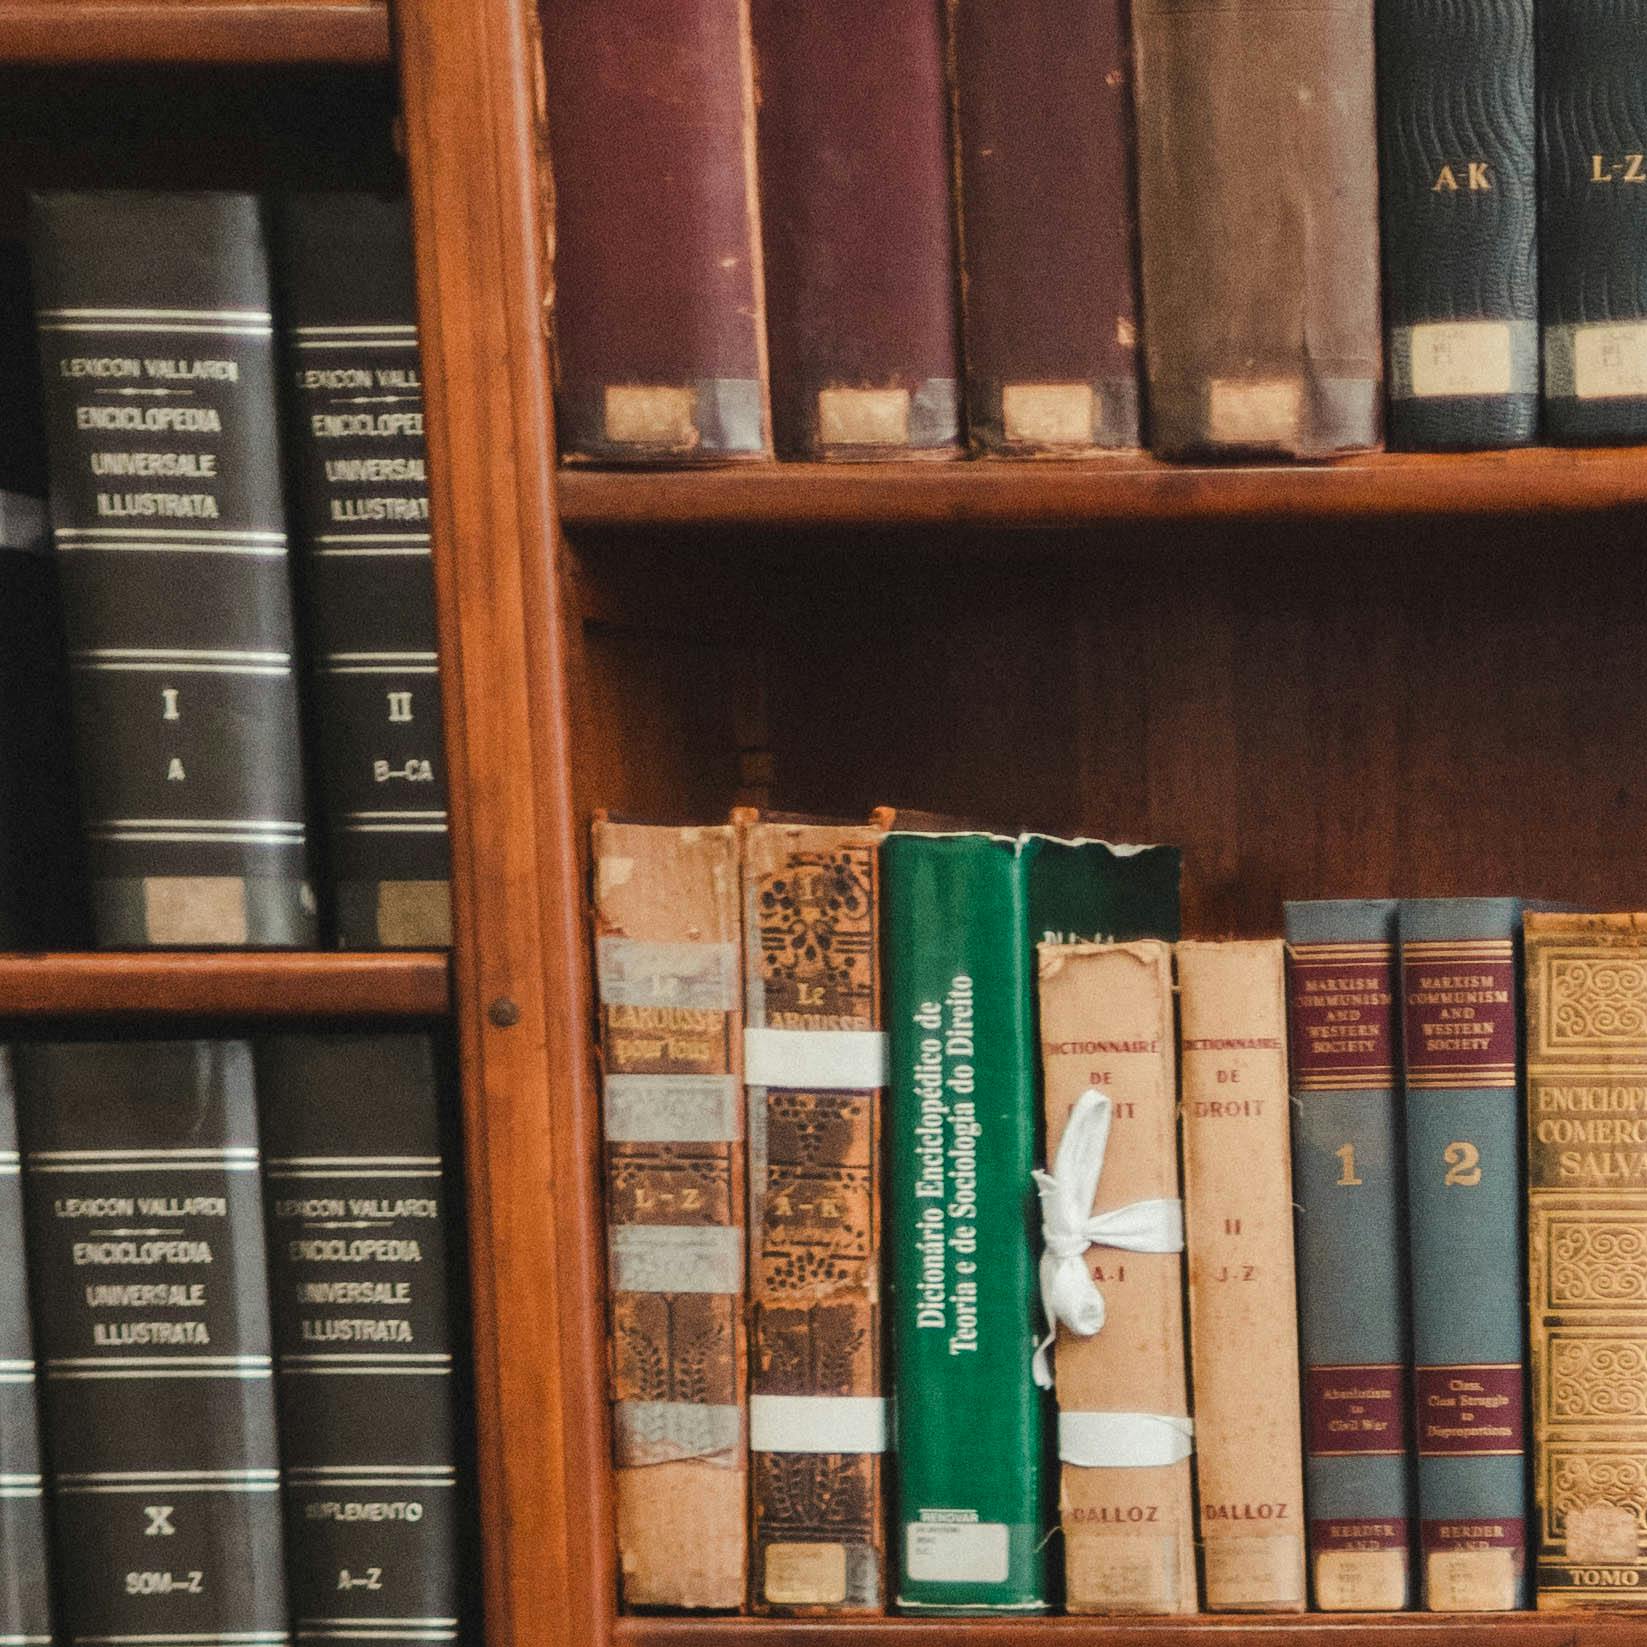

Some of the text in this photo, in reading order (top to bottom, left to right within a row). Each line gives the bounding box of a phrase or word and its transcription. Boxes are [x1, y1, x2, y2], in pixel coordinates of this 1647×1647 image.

[1431, 162, 1491, 193] A-K
[1589, 153, 1647, 184] L-Z
[60, 358, 239, 382] LEXICON VALLARDI
[77, 407, 221, 432] ENCICLOPEDIA
[91, 453, 218, 477] UNIVERSALE
[98, 494, 219, 518] ILLUSTRATA
[162, 689, 179, 719] I
[387, 691, 413, 722] II
[166, 758, 186, 781] A
[1305, 978, 1379, 992] MARXISM
[1419, 976, 1495, 989] MARXISM
[1327, 1010, 1361, 1022] AND
[1440, 1007, 1476, 1019] AND
[1307, 1024, 1381, 1038] WESTERN
[1422, 1022, 1495, 1036] WESTERN
[1312, 1040, 1376, 1053] SOCIETY
[1426, 1038, 1490, 1051] SOCIETY
[1089, 1071, 1112, 1085] DE
[1216, 1070, 1240, 1084] DE
[1195, 1100, 1265, 1118] DROIT
[913, 1000, 950, 1329] Dicionário Enciclopédico de
[945, 974, 983, 1356] Teoria e de Sociologia do Direito
[1336, 1142, 1363, 1185] 1
[1443, 1141, 1482, 1186] 2
[54, 1198, 134, 1217] LEXICON
[73, 1241, 213, 1265] ENCICLOPEDIA
[86, 1284, 205, 1306] UNIVERSALE
[93, 1322, 210, 1345] ILLUSTRATA
[144, 1506, 175, 1536] X
[1070, 1506, 1160, 1523] DALLOZ
[1204, 1503, 1290, 1522] DALLOZ
[1569, 1569, 1639, 1586] TOMO
